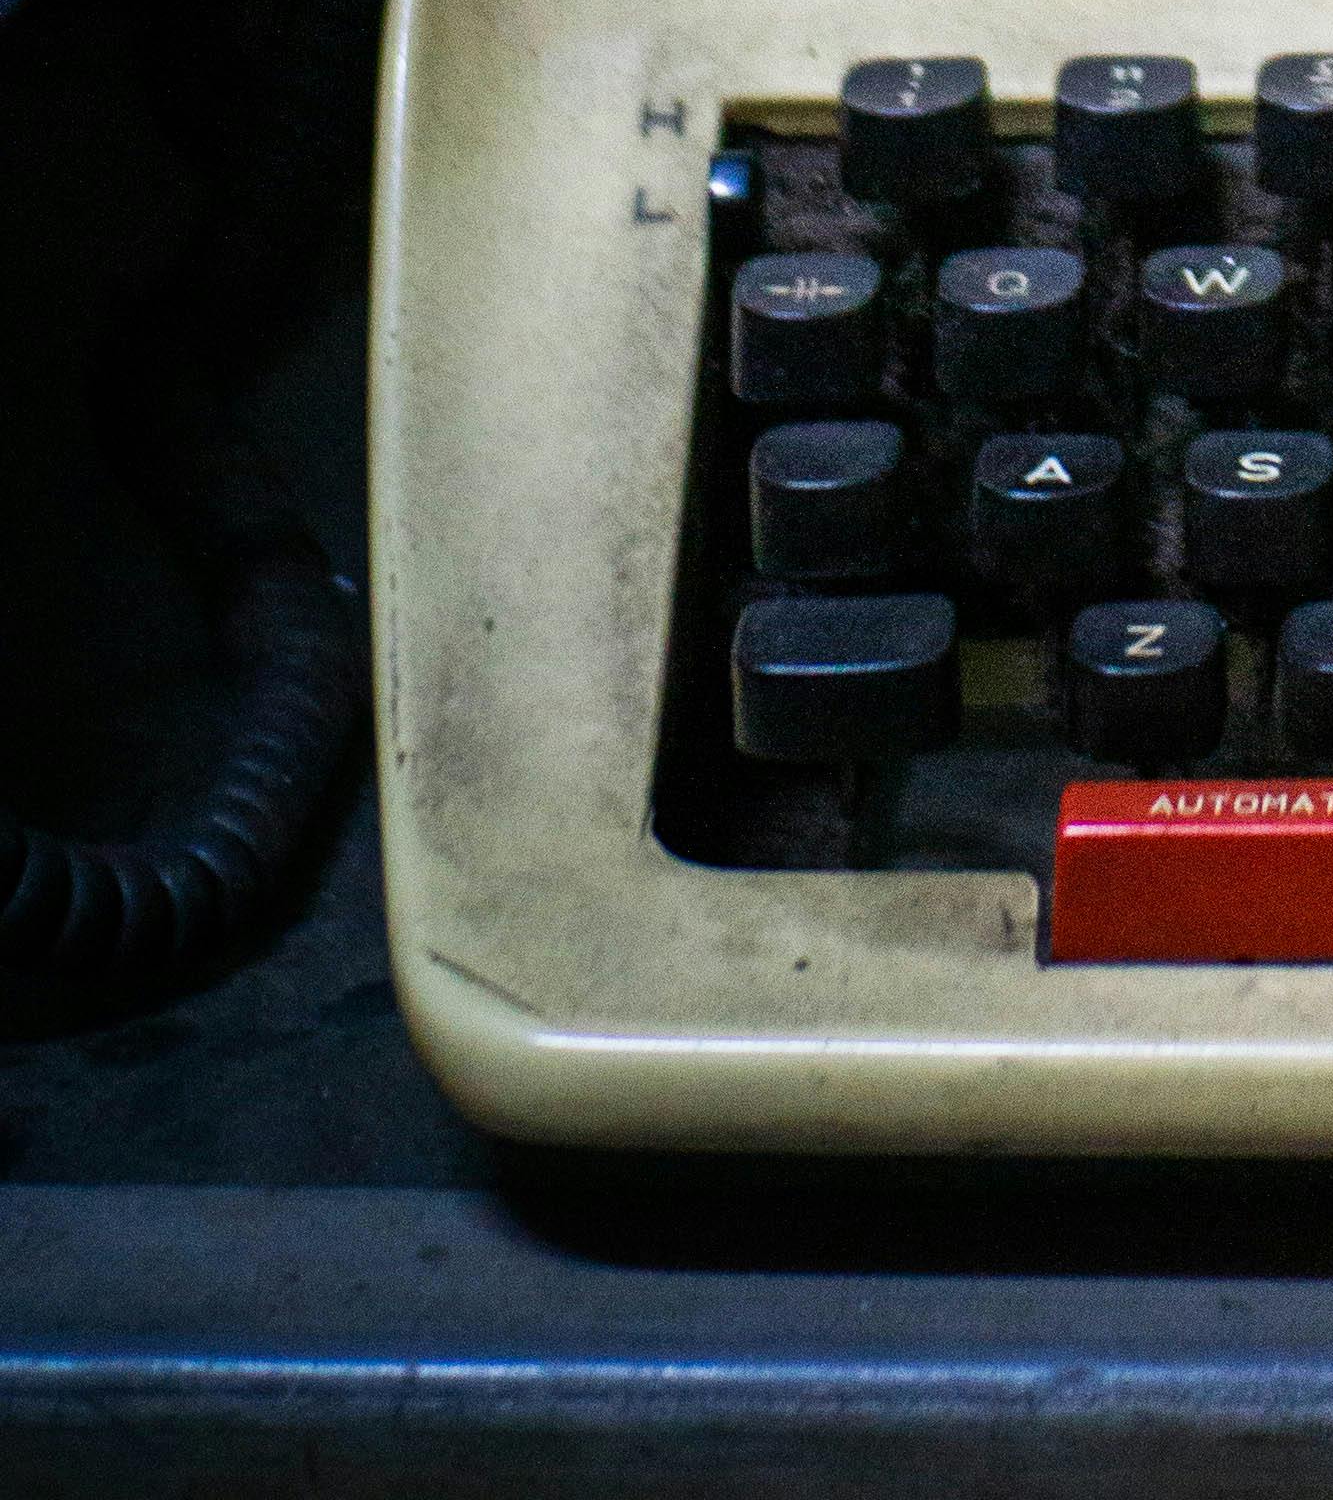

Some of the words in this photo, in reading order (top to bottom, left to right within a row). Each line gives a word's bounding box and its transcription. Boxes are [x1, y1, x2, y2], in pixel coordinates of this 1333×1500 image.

[987, 269, 1029, 297] Q
[1182, 266, 1249, 295] W
[1025, 455, 1072, 485] A
[1237, 452, 1283, 482] S
[1125, 624, 1167, 658] Z
